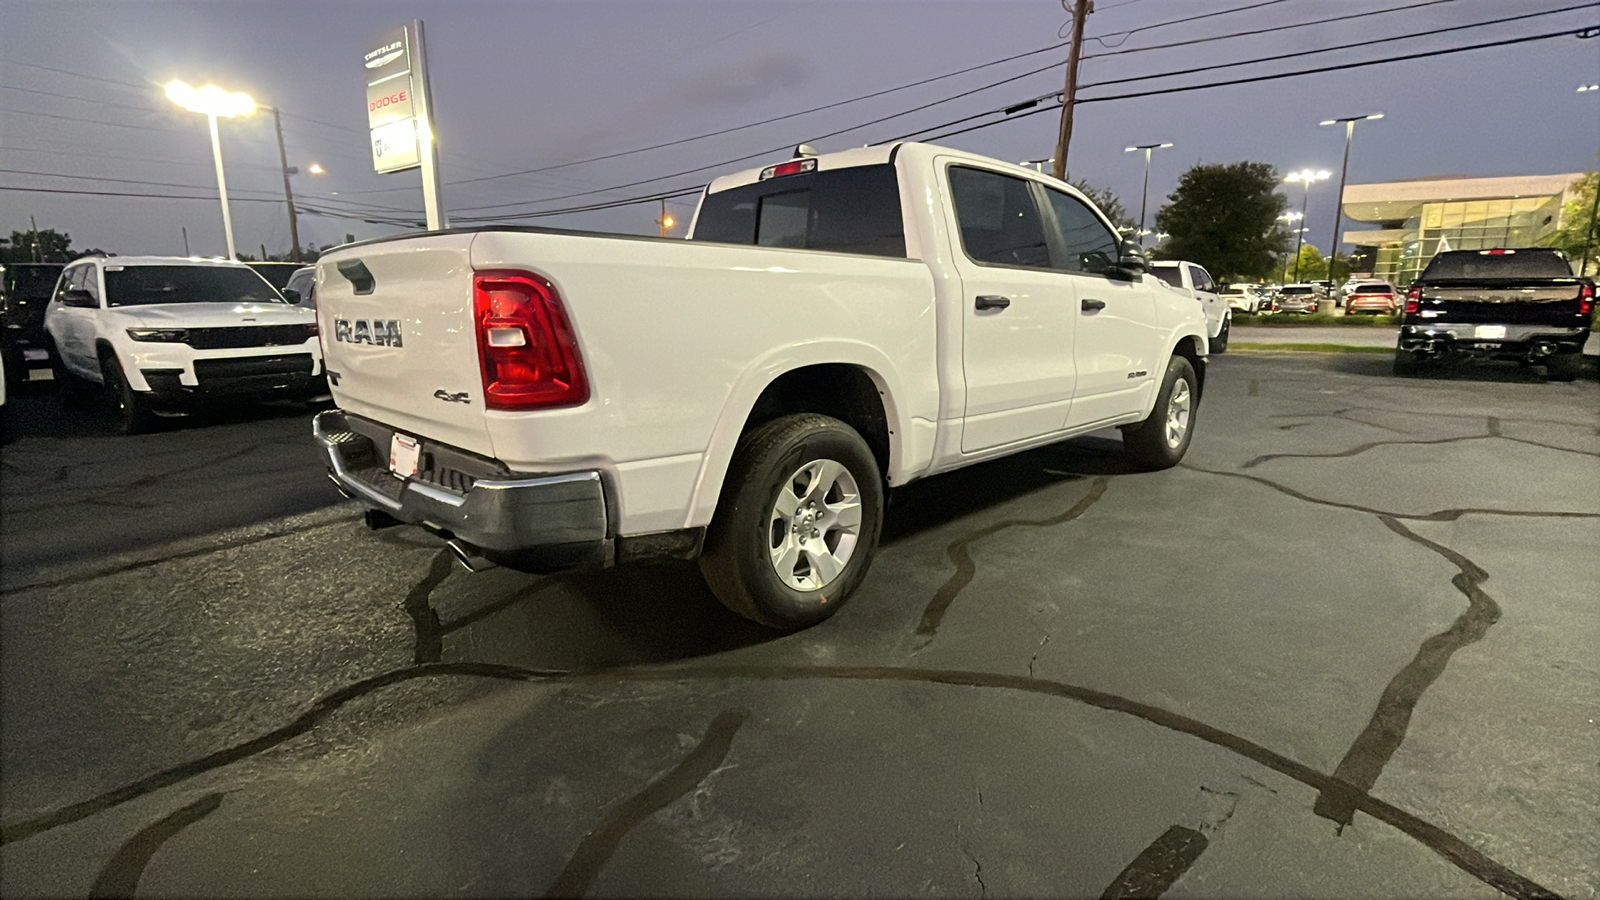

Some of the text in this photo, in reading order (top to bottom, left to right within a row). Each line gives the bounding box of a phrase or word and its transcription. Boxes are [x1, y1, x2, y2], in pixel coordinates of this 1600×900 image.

[364, 41, 402, 61] CHRYSLER
[369, 90, 408, 112] DODGE
[335, 319, 403, 348] RAM
